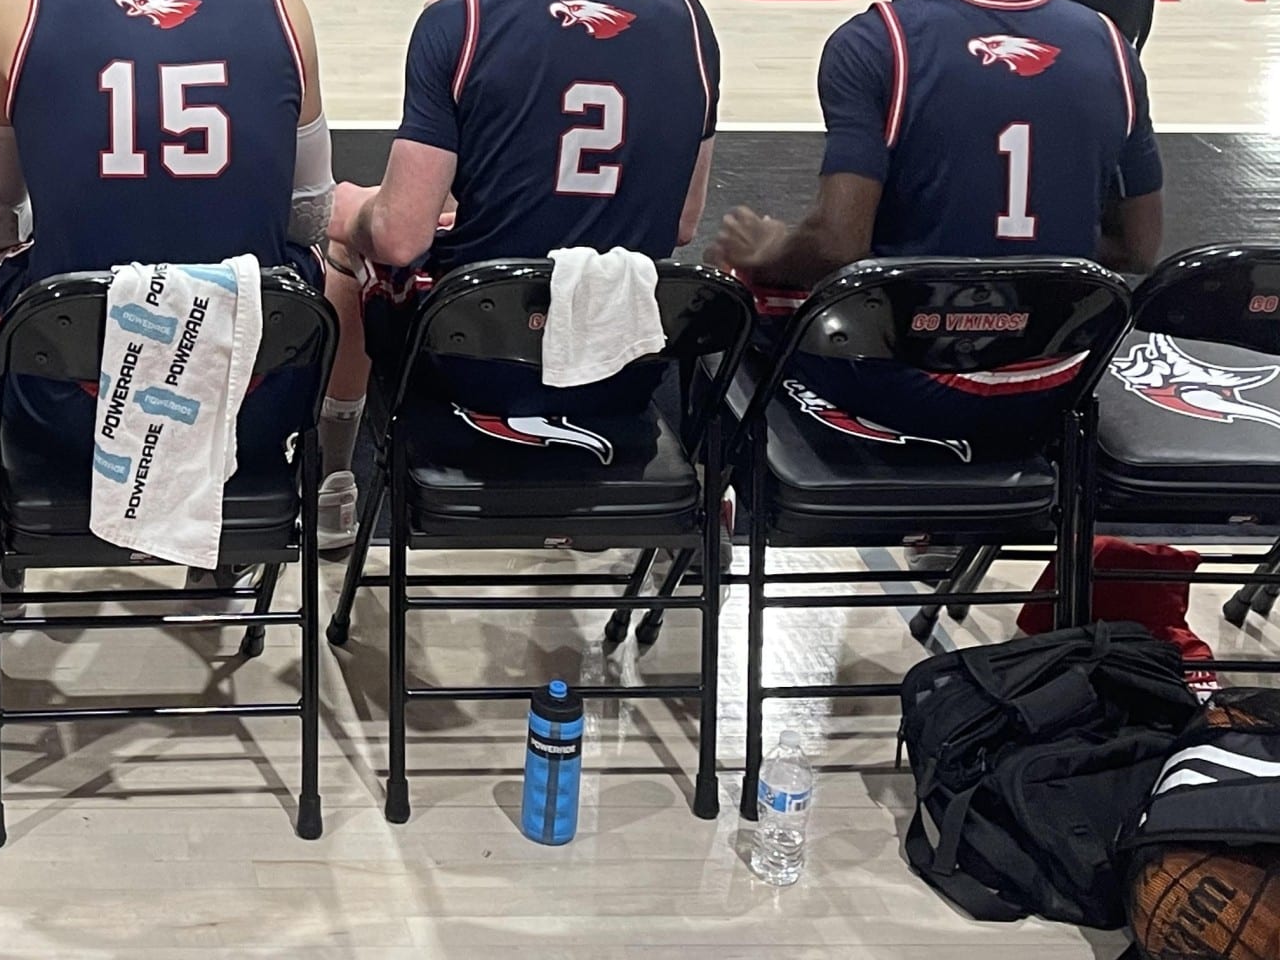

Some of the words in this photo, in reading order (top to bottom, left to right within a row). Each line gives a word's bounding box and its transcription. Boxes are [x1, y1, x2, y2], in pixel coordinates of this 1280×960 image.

[98, 58, 232, 179] 15
[553, 80, 626, 197] 2
[995, 120, 1037, 240] 1
[165, 297, 209, 386] POWERADE
[911, 313, 941, 331] GO
[945, 312, 1030, 331] VIKINGS!
[1249, 295, 1279, 313] GO
[101, 342, 143, 440] POWERADE
[124, 424, 164, 520] POWERADE
